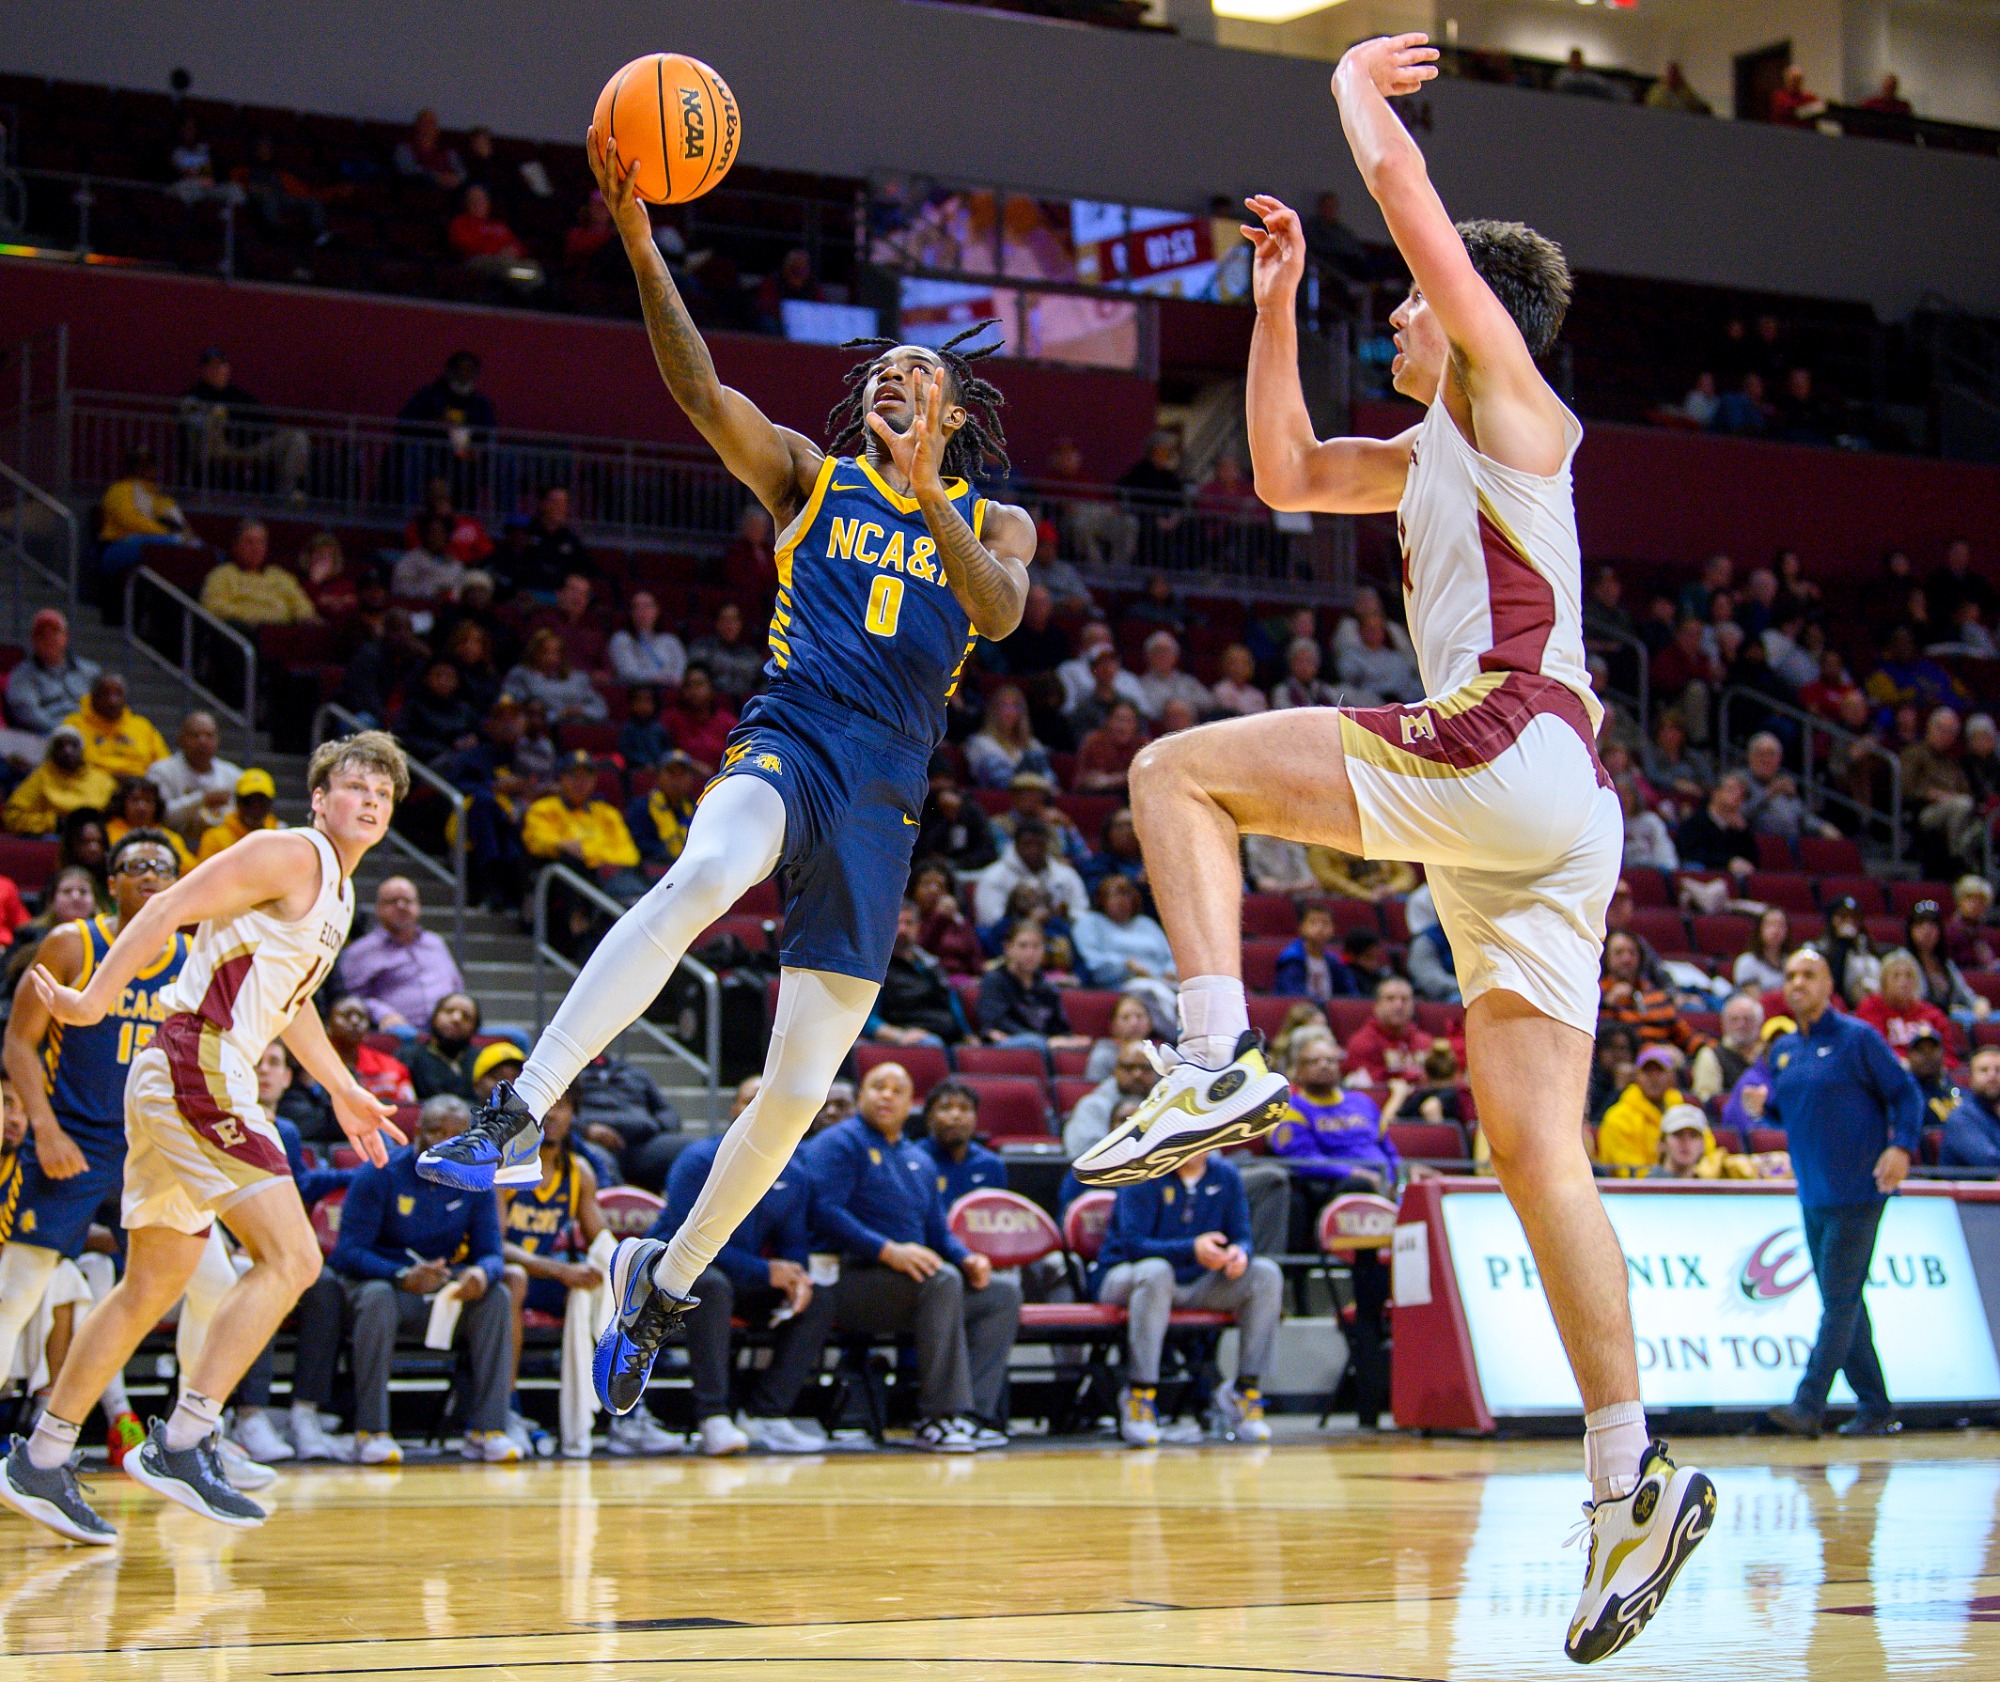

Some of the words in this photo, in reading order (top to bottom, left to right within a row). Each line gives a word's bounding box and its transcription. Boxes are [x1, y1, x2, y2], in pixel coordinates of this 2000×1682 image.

[680, 87, 704, 160] NCAA
[711, 76, 738, 174] Wilson
[826, 517, 947, 588] NCA&
[865, 574, 904, 637] 0
[211, 1117, 247, 1148] E
[965, 1209, 1040, 1233] ELON
[1485, 1256, 1708, 1288] PHNIX
[1864, 1256, 1946, 1288] LUB
[1636, 1337, 1711, 1371] OIN
[1722, 1337, 1812, 1370] TOD
